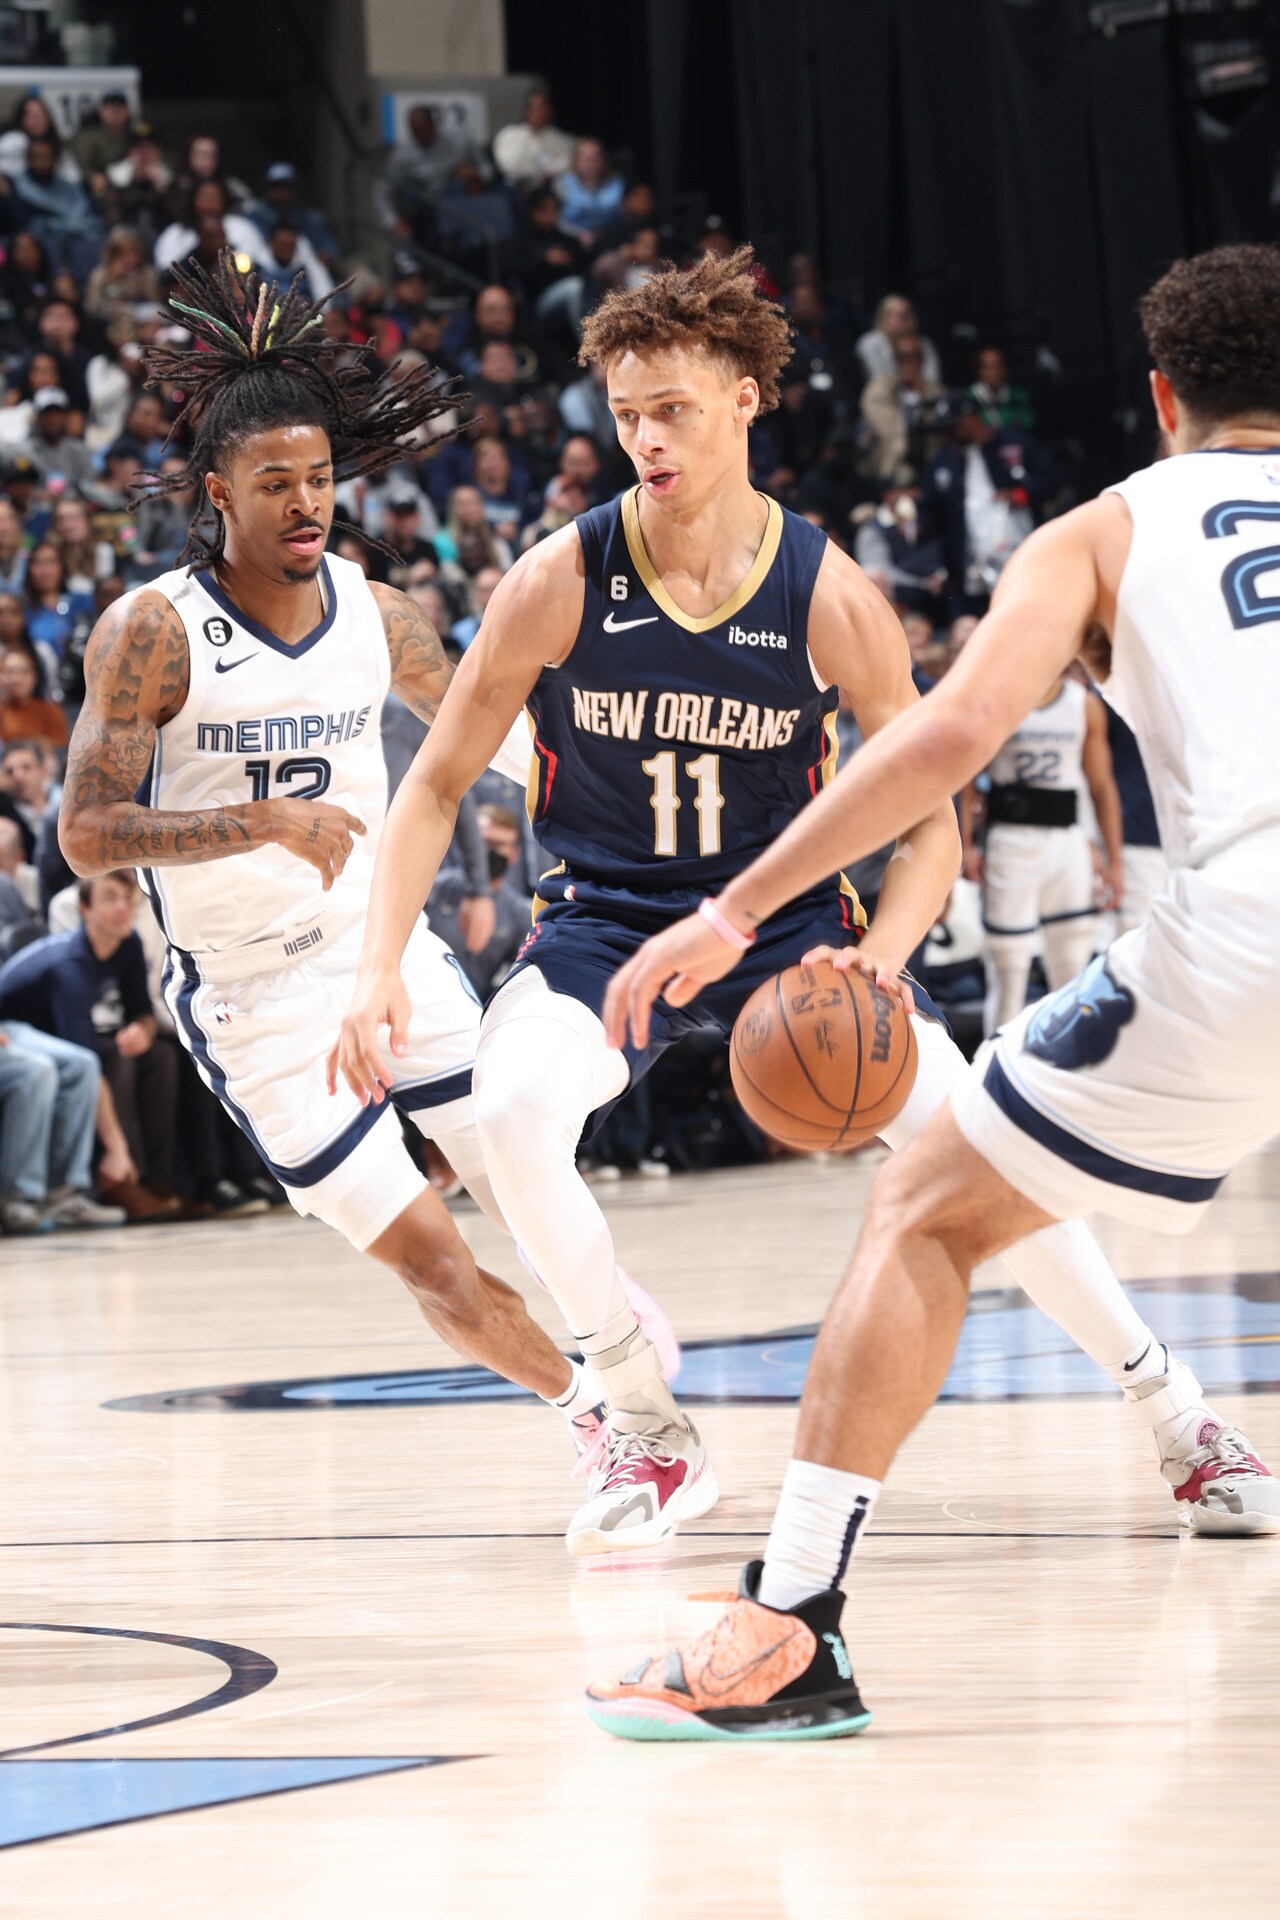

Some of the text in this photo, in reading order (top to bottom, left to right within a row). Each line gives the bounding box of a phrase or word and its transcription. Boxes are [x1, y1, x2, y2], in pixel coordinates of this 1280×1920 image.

[611, 575, 628, 600] 6
[207, 620, 226, 645] 6
[728, 626, 788, 649] ibotta
[197, 706, 371, 753] MEMPHIS
[572, 686, 801, 750] NEW ORLEANS
[245, 757, 332, 802] 12
[1015, 751, 1062, 783] 22
[641, 751, 726, 857] 11
